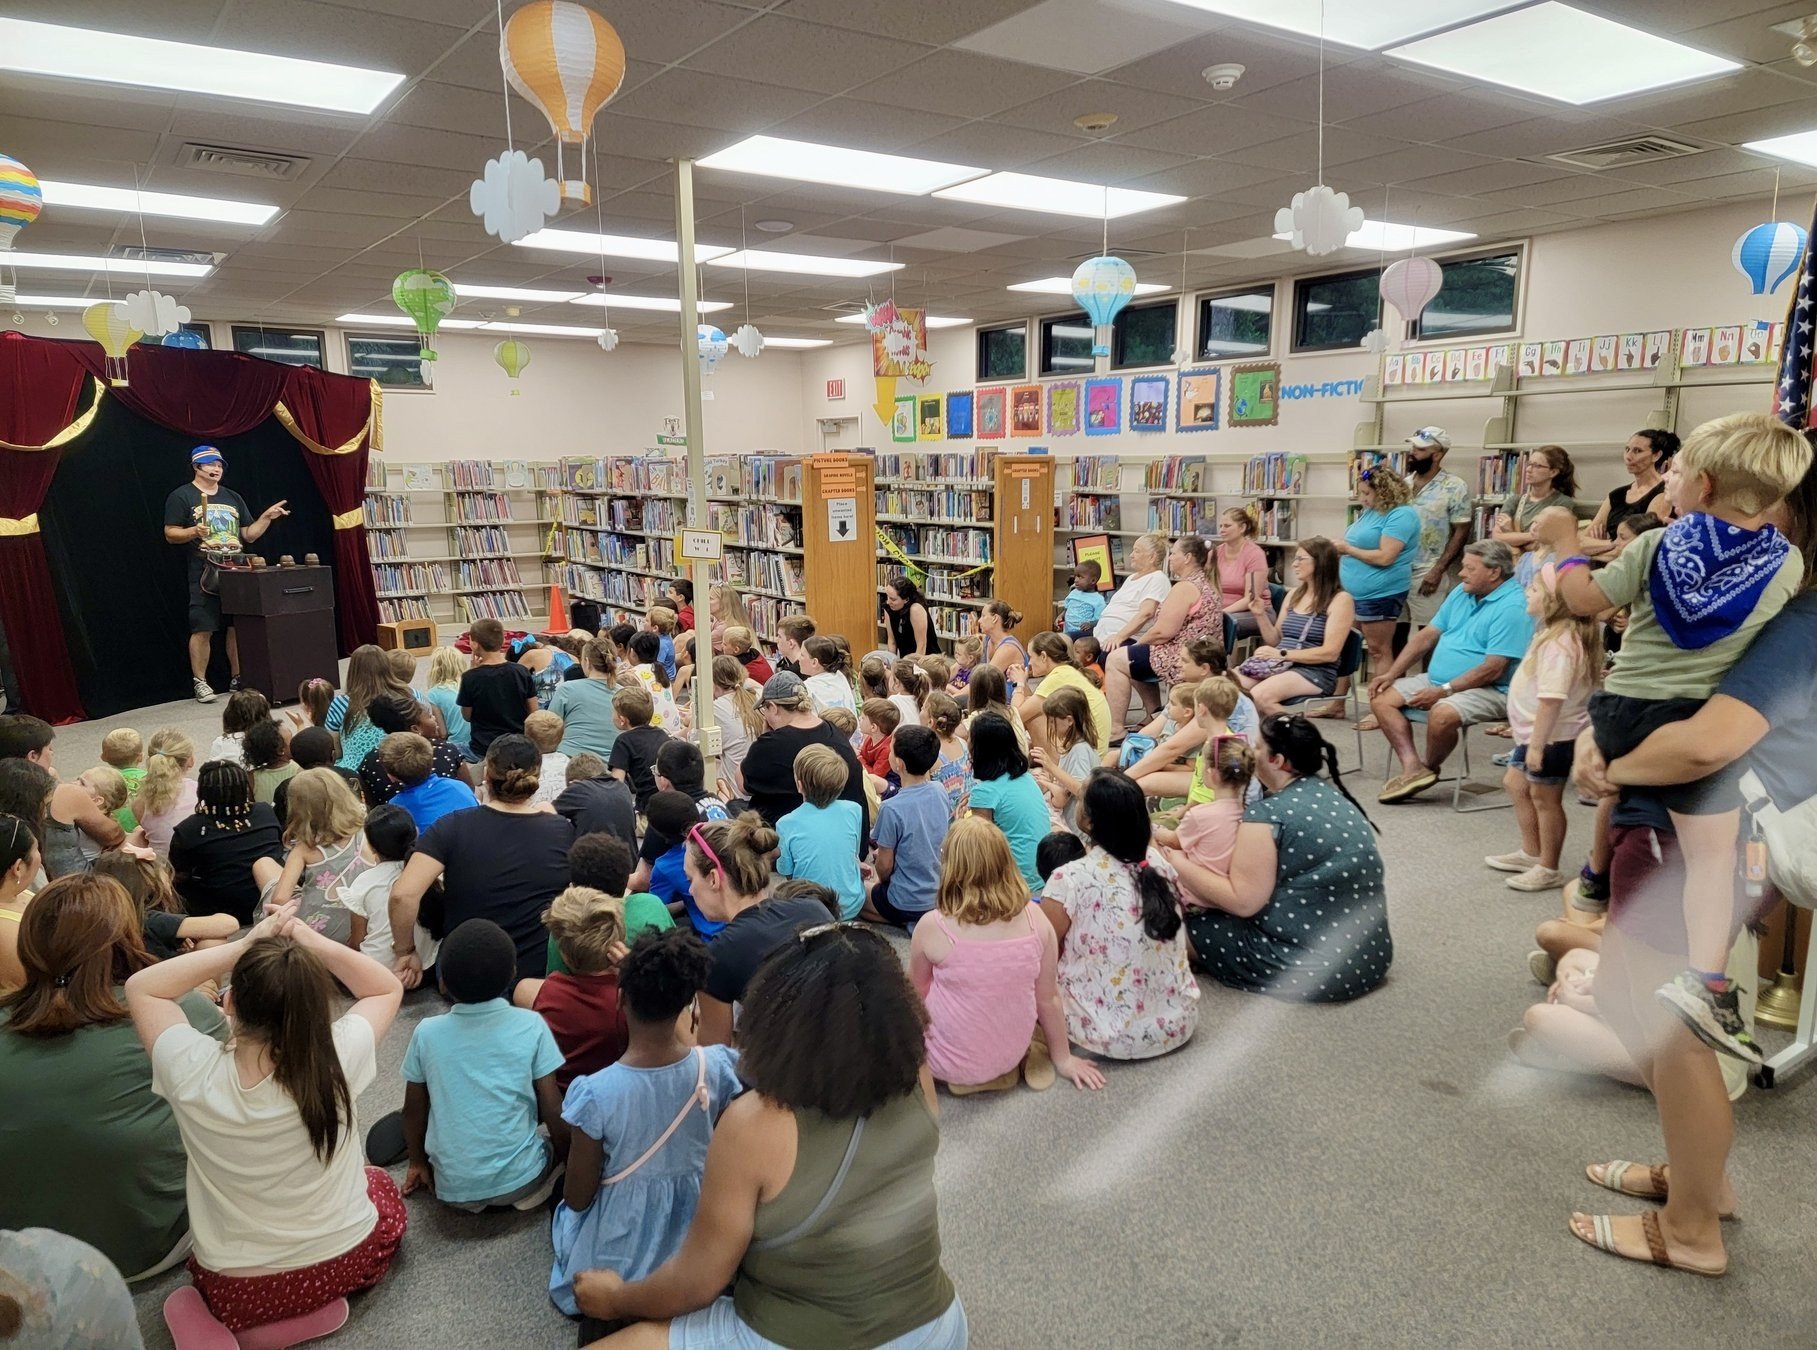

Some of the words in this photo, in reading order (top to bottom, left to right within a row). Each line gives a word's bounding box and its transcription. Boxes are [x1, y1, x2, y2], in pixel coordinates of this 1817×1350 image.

[1653, 335, 1663, 346] Ll
[1691, 332, 1704, 342] Mm
[1720, 330, 1734, 341] Nn
[1578, 342, 1586, 352] Ii
[1599, 338, 1611, 352] Jj
[1625, 337, 1638, 347] Kk
[1472, 350, 1482, 360] Ee
[1495, 348, 1505, 358] Ff
[1525, 347, 1537, 357] Gg
[1411, 355, 1421, 364] Bb
[829, 381, 841, 397] EXIT
